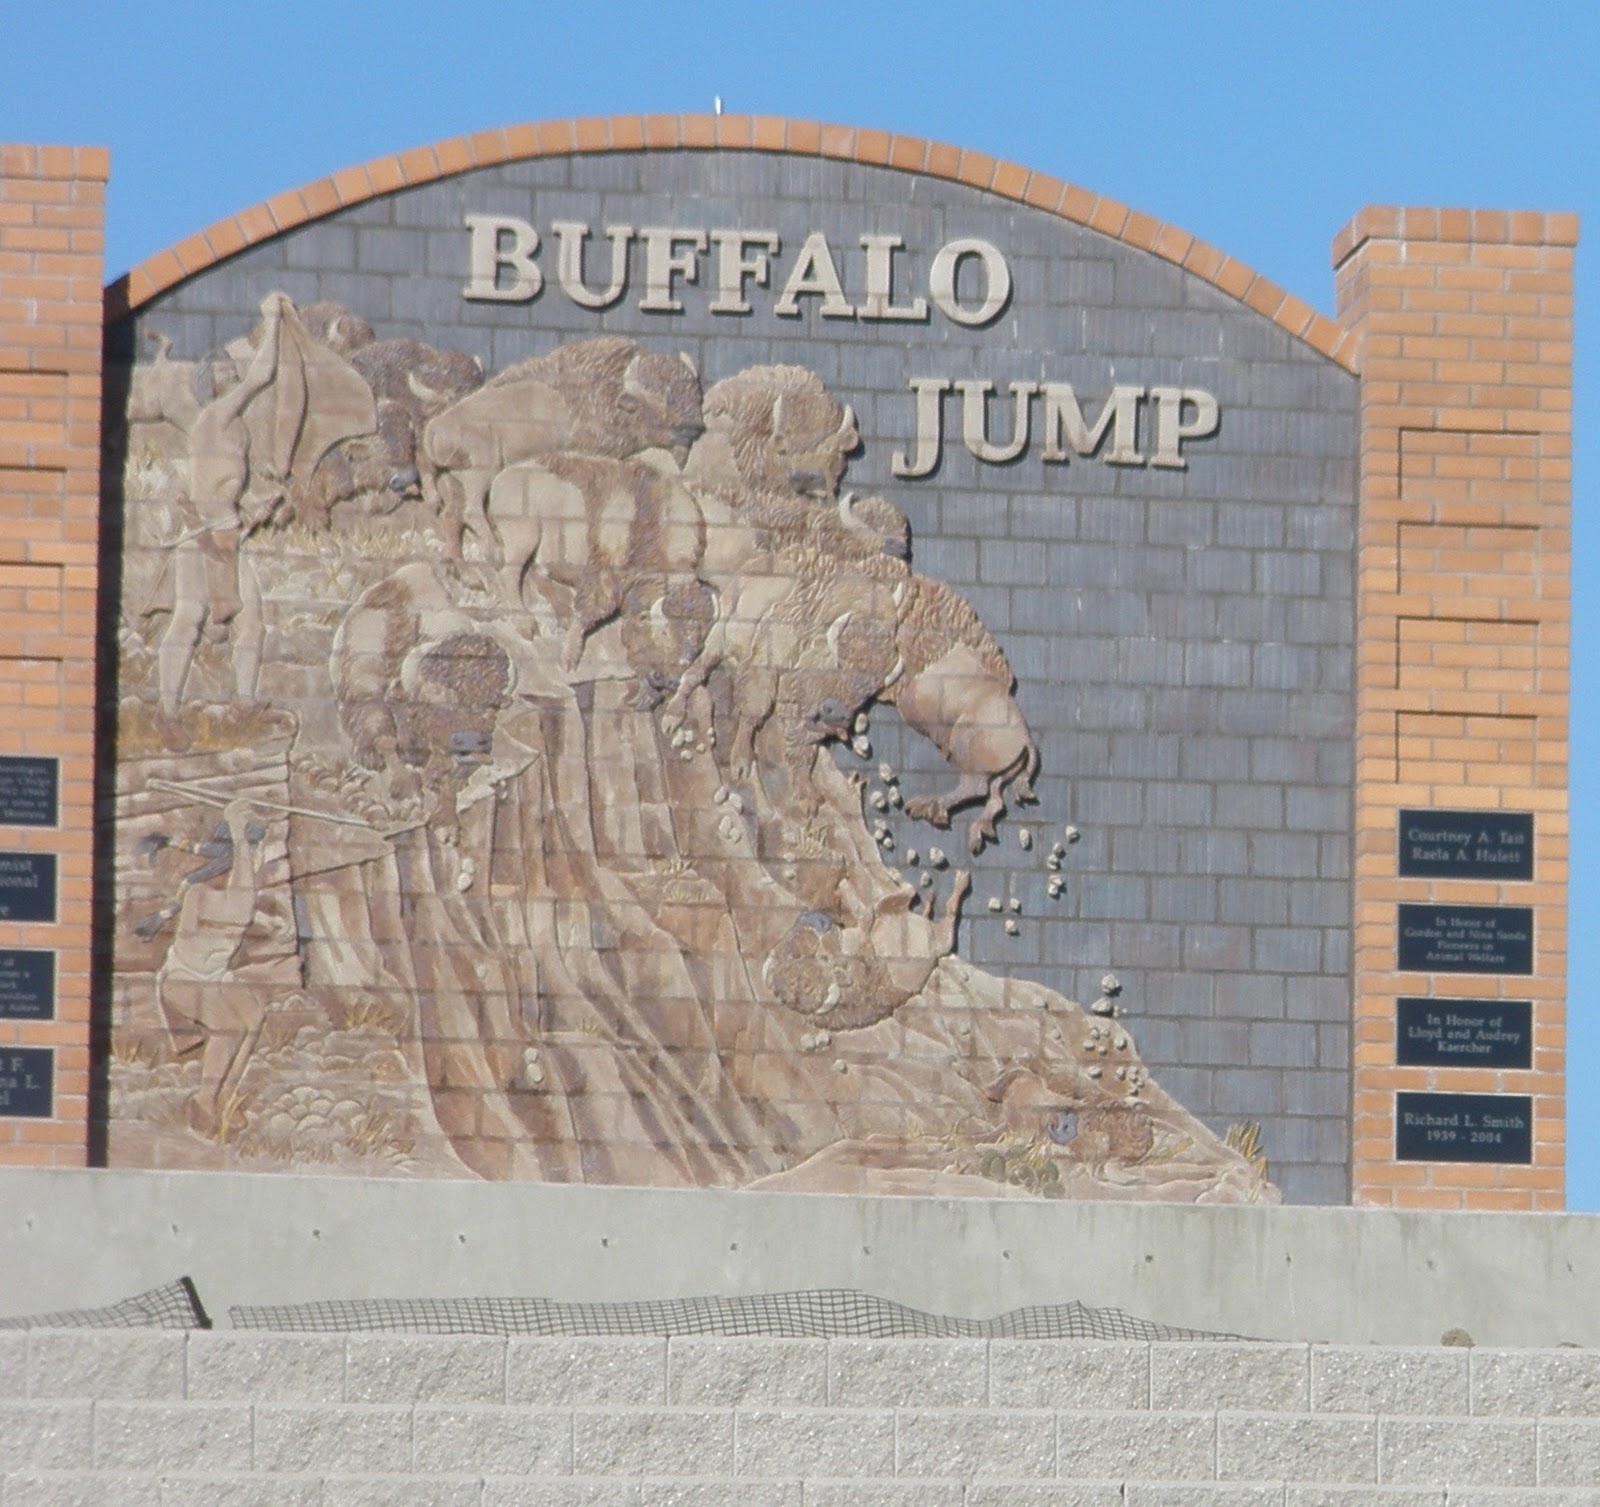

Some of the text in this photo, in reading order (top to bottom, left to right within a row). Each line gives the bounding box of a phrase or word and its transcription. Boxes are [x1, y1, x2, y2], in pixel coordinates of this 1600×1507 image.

[463, 213, 1012, 326] BUFFALO
[891, 377, 1220, 478] JUMP
[1407, 827, 1472, 845] Courtney
[1427, 1013, 1503, 1028] In Honor of
[1408, 1026, 1521, 1045] Lloyd and Audrey
[1403, 1112, 1459, 1127] Richard
[1482, 1114, 1525, 1129] Smith
[1427, 1130, 1456, 1142] 1939
